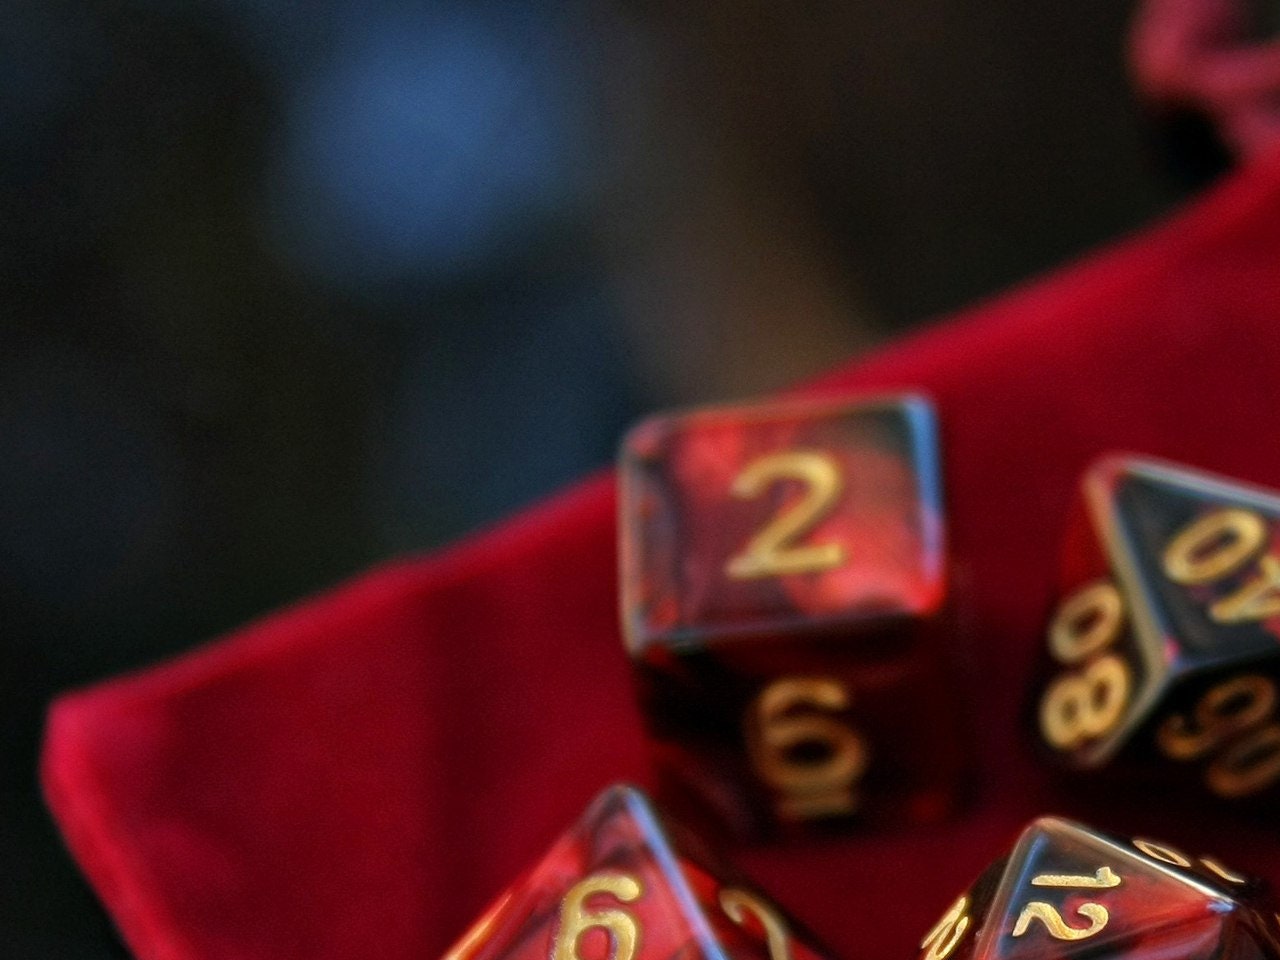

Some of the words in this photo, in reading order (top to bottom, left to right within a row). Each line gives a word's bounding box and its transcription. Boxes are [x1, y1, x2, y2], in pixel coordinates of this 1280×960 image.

[724, 452, 847, 580] 2
[1040, 582, 1130, 750] 80
[746, 677, 867, 819] 6
[1012, 866, 1121, 940] 12
